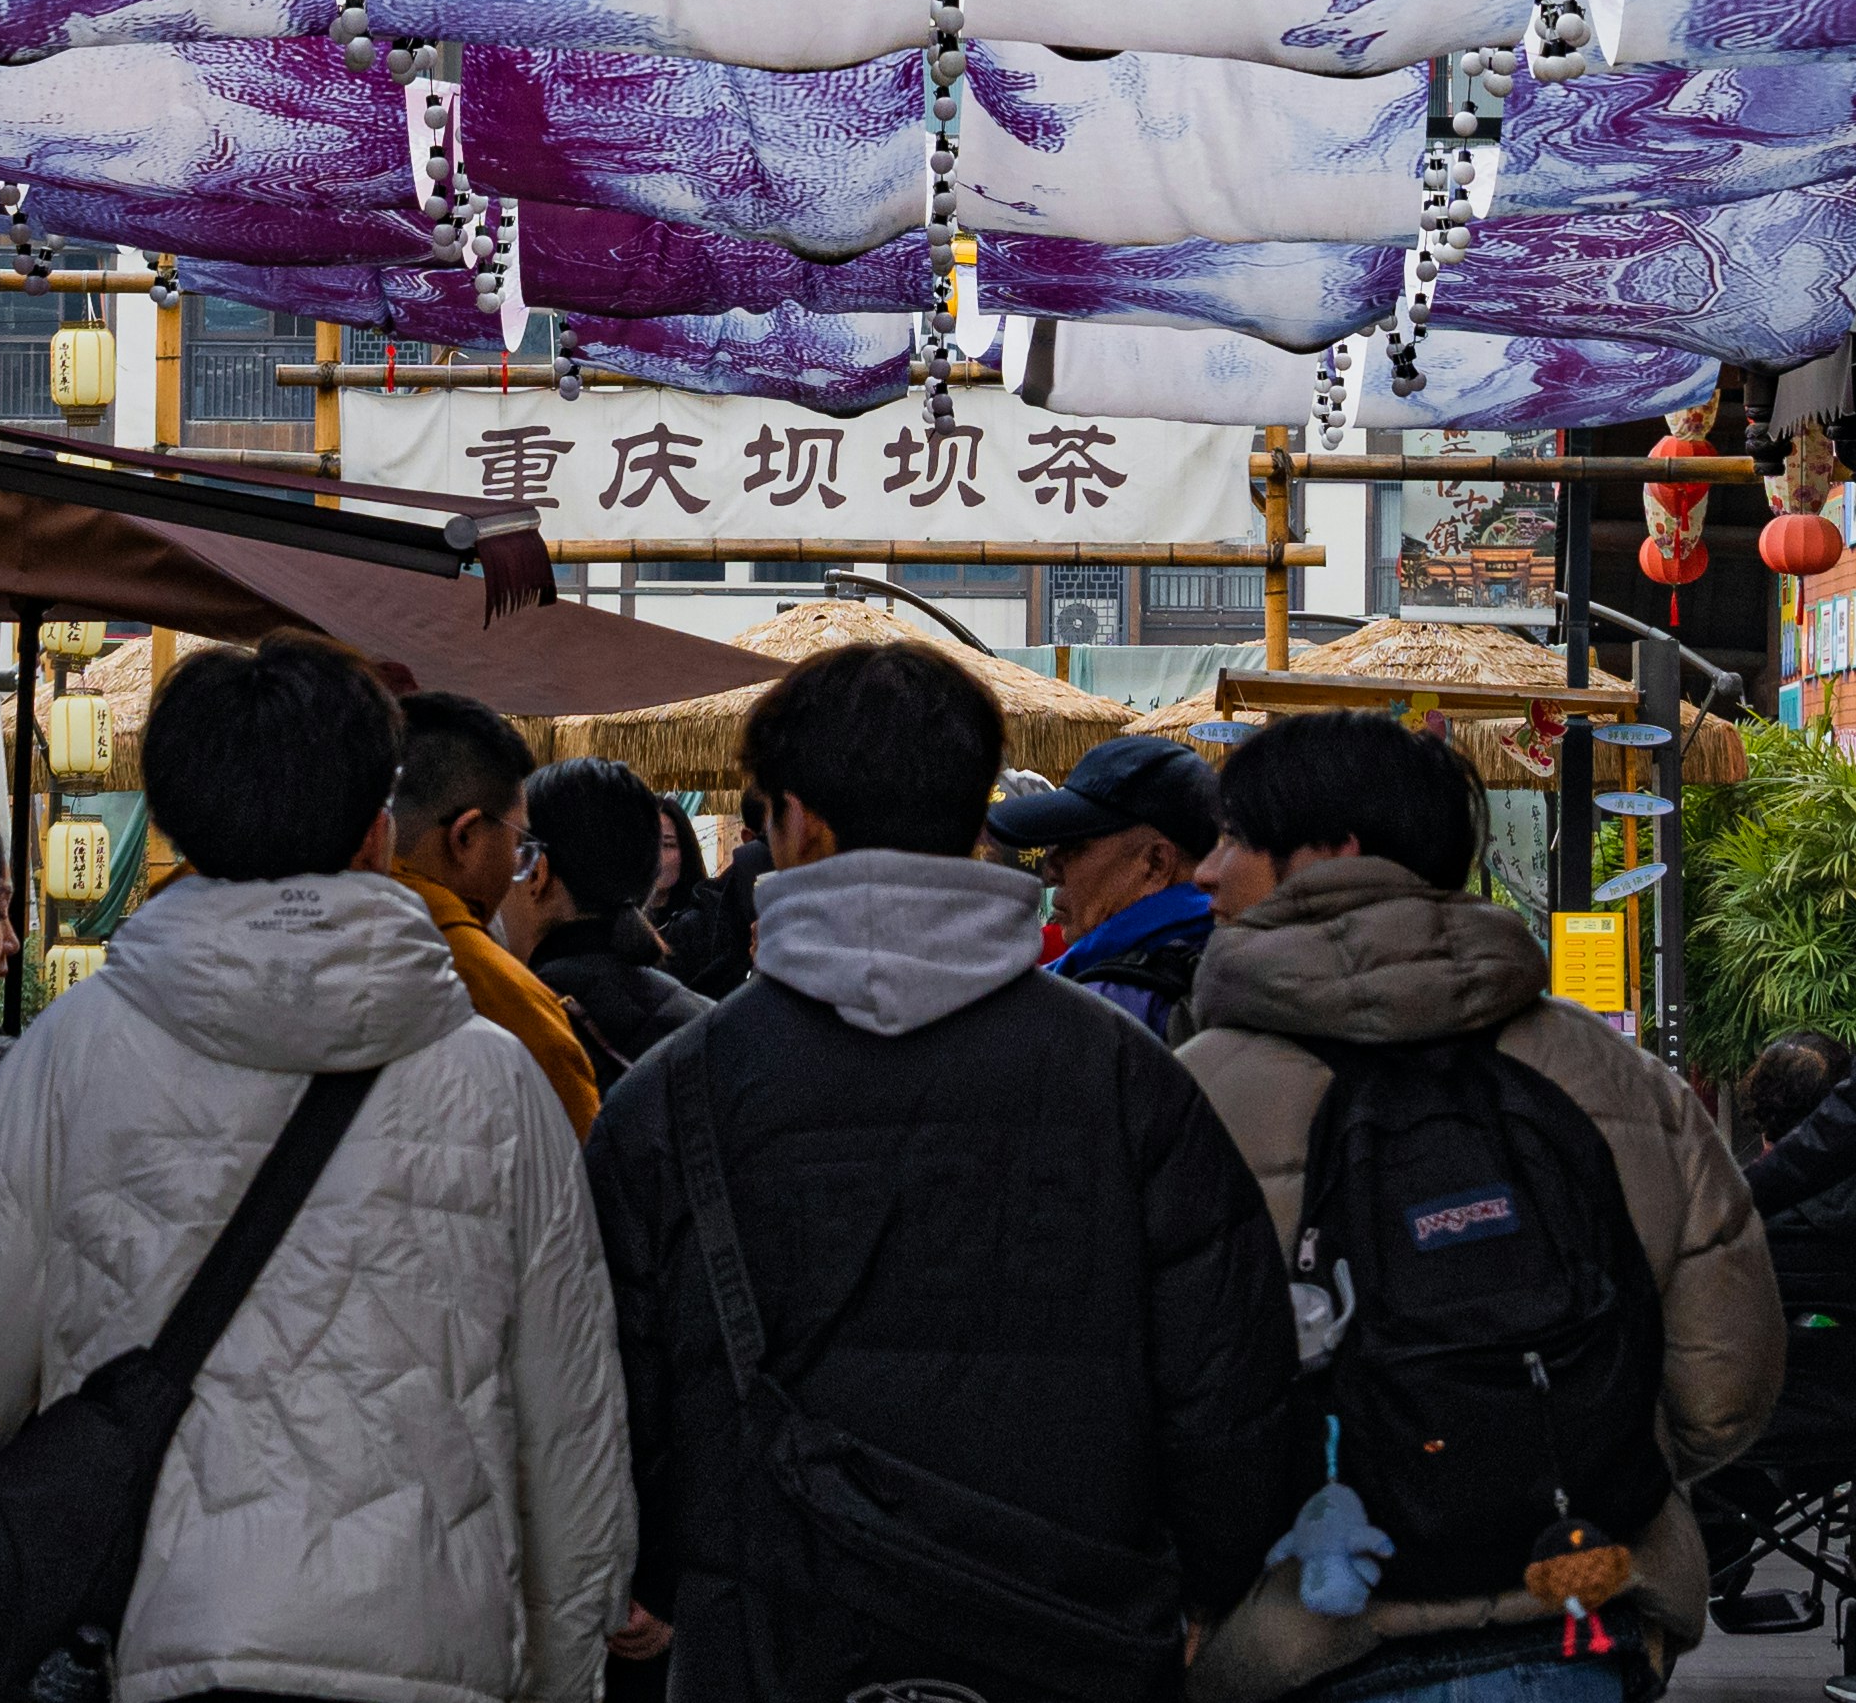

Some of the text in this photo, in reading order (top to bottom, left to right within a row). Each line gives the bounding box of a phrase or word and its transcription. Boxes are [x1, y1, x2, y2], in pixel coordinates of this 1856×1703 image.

[464, 422, 1129, 515] 重庆坝坝茶
[1607, 730, 1655, 742] 鲜果现切
